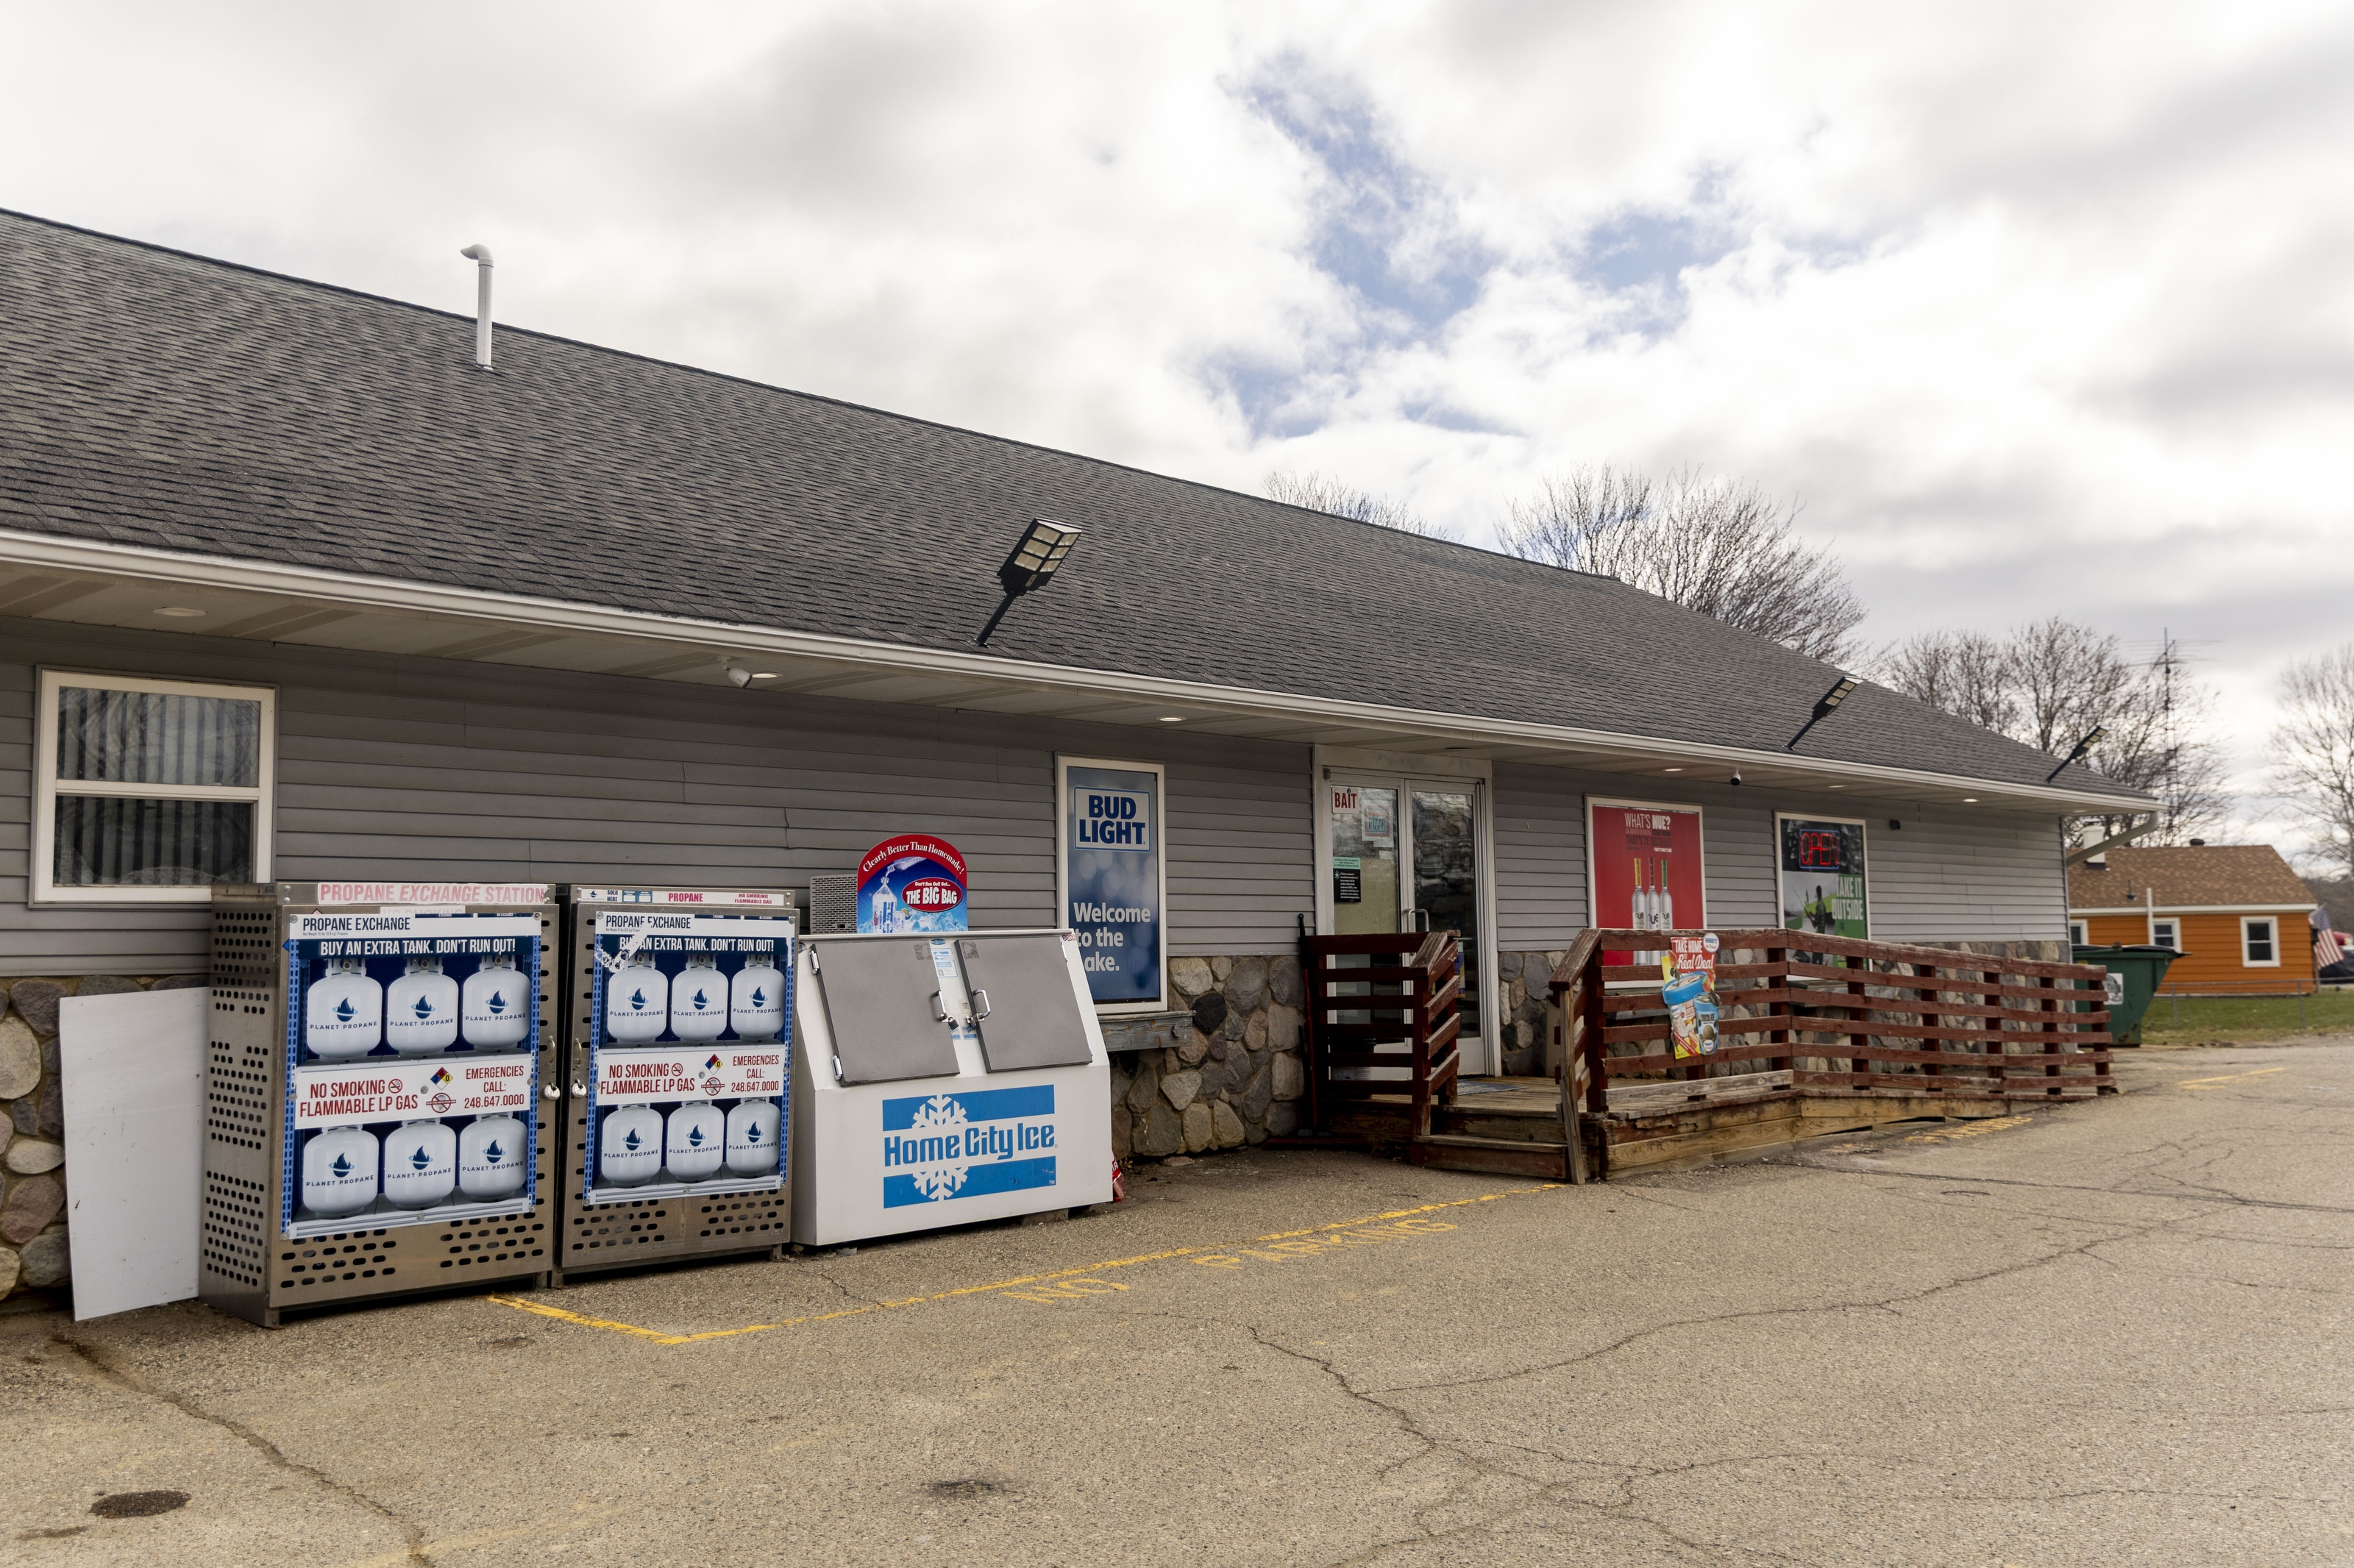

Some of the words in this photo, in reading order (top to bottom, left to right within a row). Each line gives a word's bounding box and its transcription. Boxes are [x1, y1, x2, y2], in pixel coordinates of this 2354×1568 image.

[1088, 794, 1137, 819] BUD
[1334, 792, 1357, 809] BAIT
[1624, 812, 1651, 830] WHAT'S
[1651, 814, 1671, 830] NUE?
[1079, 819, 1145, 845] LIGHT
[862, 850, 887, 872] Clearly
[886, 844, 910, 856] Better
[910, 841, 928, 852] Than
[1800, 833, 1839, 866] OPEN
[320, 883, 395, 902] PROPANE
[399, 885, 480, 902] EXCHANGE
[485, 886, 544, 903] STATION
[906, 888, 921, 905] THE
[922, 886, 940, 905] BIG
[941, 890, 958, 905] BAG
[1855, 877, 1863, 898] IT
[668, 892, 703, 902] PROPANE
[1073, 902, 1151, 924] Welcome
[1832, 898, 1864, 920] OUTSIDE
[303, 917, 352, 931] PROPANE
[355, 917, 410, 931] EXCHANGE
[639, 937, 652, 950] AN
[654, 938, 683, 951] EXTRA
[684, 938, 709, 951] TANK.
[711, 938, 736, 952] DON'T
[737, 939, 754, 952] RUN
[755, 939, 774, 952] OUT!
[1075, 928, 1092, 947] to
[1095, 927, 1123, 948] the
[321, 941, 344, 955] BUY
[346, 941, 362, 955] AN
[365, 940, 400, 955] EXTRA
[402, 940, 433, 955] TANK.
[436, 939, 468, 954] DON'T
[470, 939, 490, 953] RUN
[493, 938, 516, 954] OUT!
[1674, 940, 1688, 953] TAKE
[1688, 940, 1702, 953] HOME
[1084, 951, 1120, 972] ake.
[1676, 954, 1695, 969] Real
[1695, 953, 1715, 970] Deal
[343, 1020, 378, 1030] PROPANE
[422, 1018, 455, 1027] PROPANE
[496, 1013, 527, 1022] PROPANE
[733, 1055, 780, 1066] EMERGENCIES
[466, 1066, 525, 1080] EMERGENCIES
[608, 1065, 623, 1079] NO
[625, 1063, 669, 1079] SMOKING
[746, 1068, 765, 1079] CALL:
[310, 1082, 327, 1099] NO
[330, 1079, 385, 1098] SMOKING
[483, 1080, 507, 1094] CALL:
[600, 1079, 662, 1095] FLAMMABLE
[663, 1078, 675, 1092] LP
[677, 1077, 695, 1091] GAS
[730, 1080, 779, 1093] 248.647.0000
[299, 1097, 376, 1117] FLAMMABLE
[378, 1096, 394, 1112] LP
[395, 1094, 418, 1111] GAS
[464, 1094, 525, 1110] 248.647.0000
[694, 1145, 721, 1153] PROPANE
[752, 1141, 778, 1150] PROPANE
[884, 1135, 960, 1166] Home
[965, 1125, 1014, 1161] City
[1017, 1122, 1055, 1151] Ice
[630, 1150, 659, 1158] PROPANE
[419, 1167, 452, 1178] PROPANE
[492, 1161, 524, 1171] PROPANE
[339, 1175, 374, 1186] PROPANE
[1000, 1277, 1131, 1304] NO
[1190, 1219, 1458, 1270] PARKING
